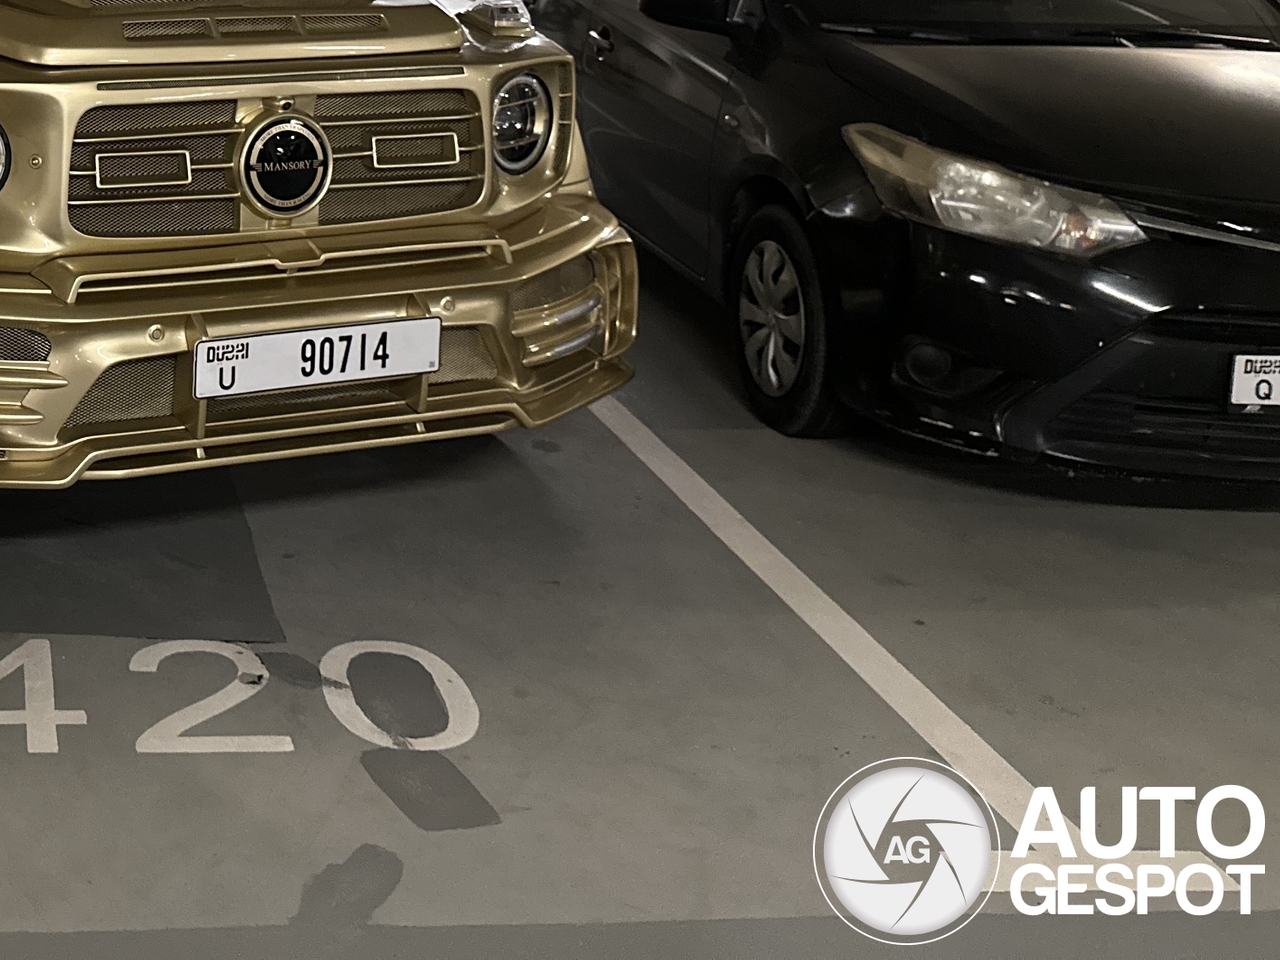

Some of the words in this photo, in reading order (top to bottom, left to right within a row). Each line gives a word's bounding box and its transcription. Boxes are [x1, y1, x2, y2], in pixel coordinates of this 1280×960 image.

[263, 159, 312, 172] MANSORY
[300, 331, 390, 378] 90714
[219, 365, 236, 391] U
[1255, 378, 1273, 401] Q
